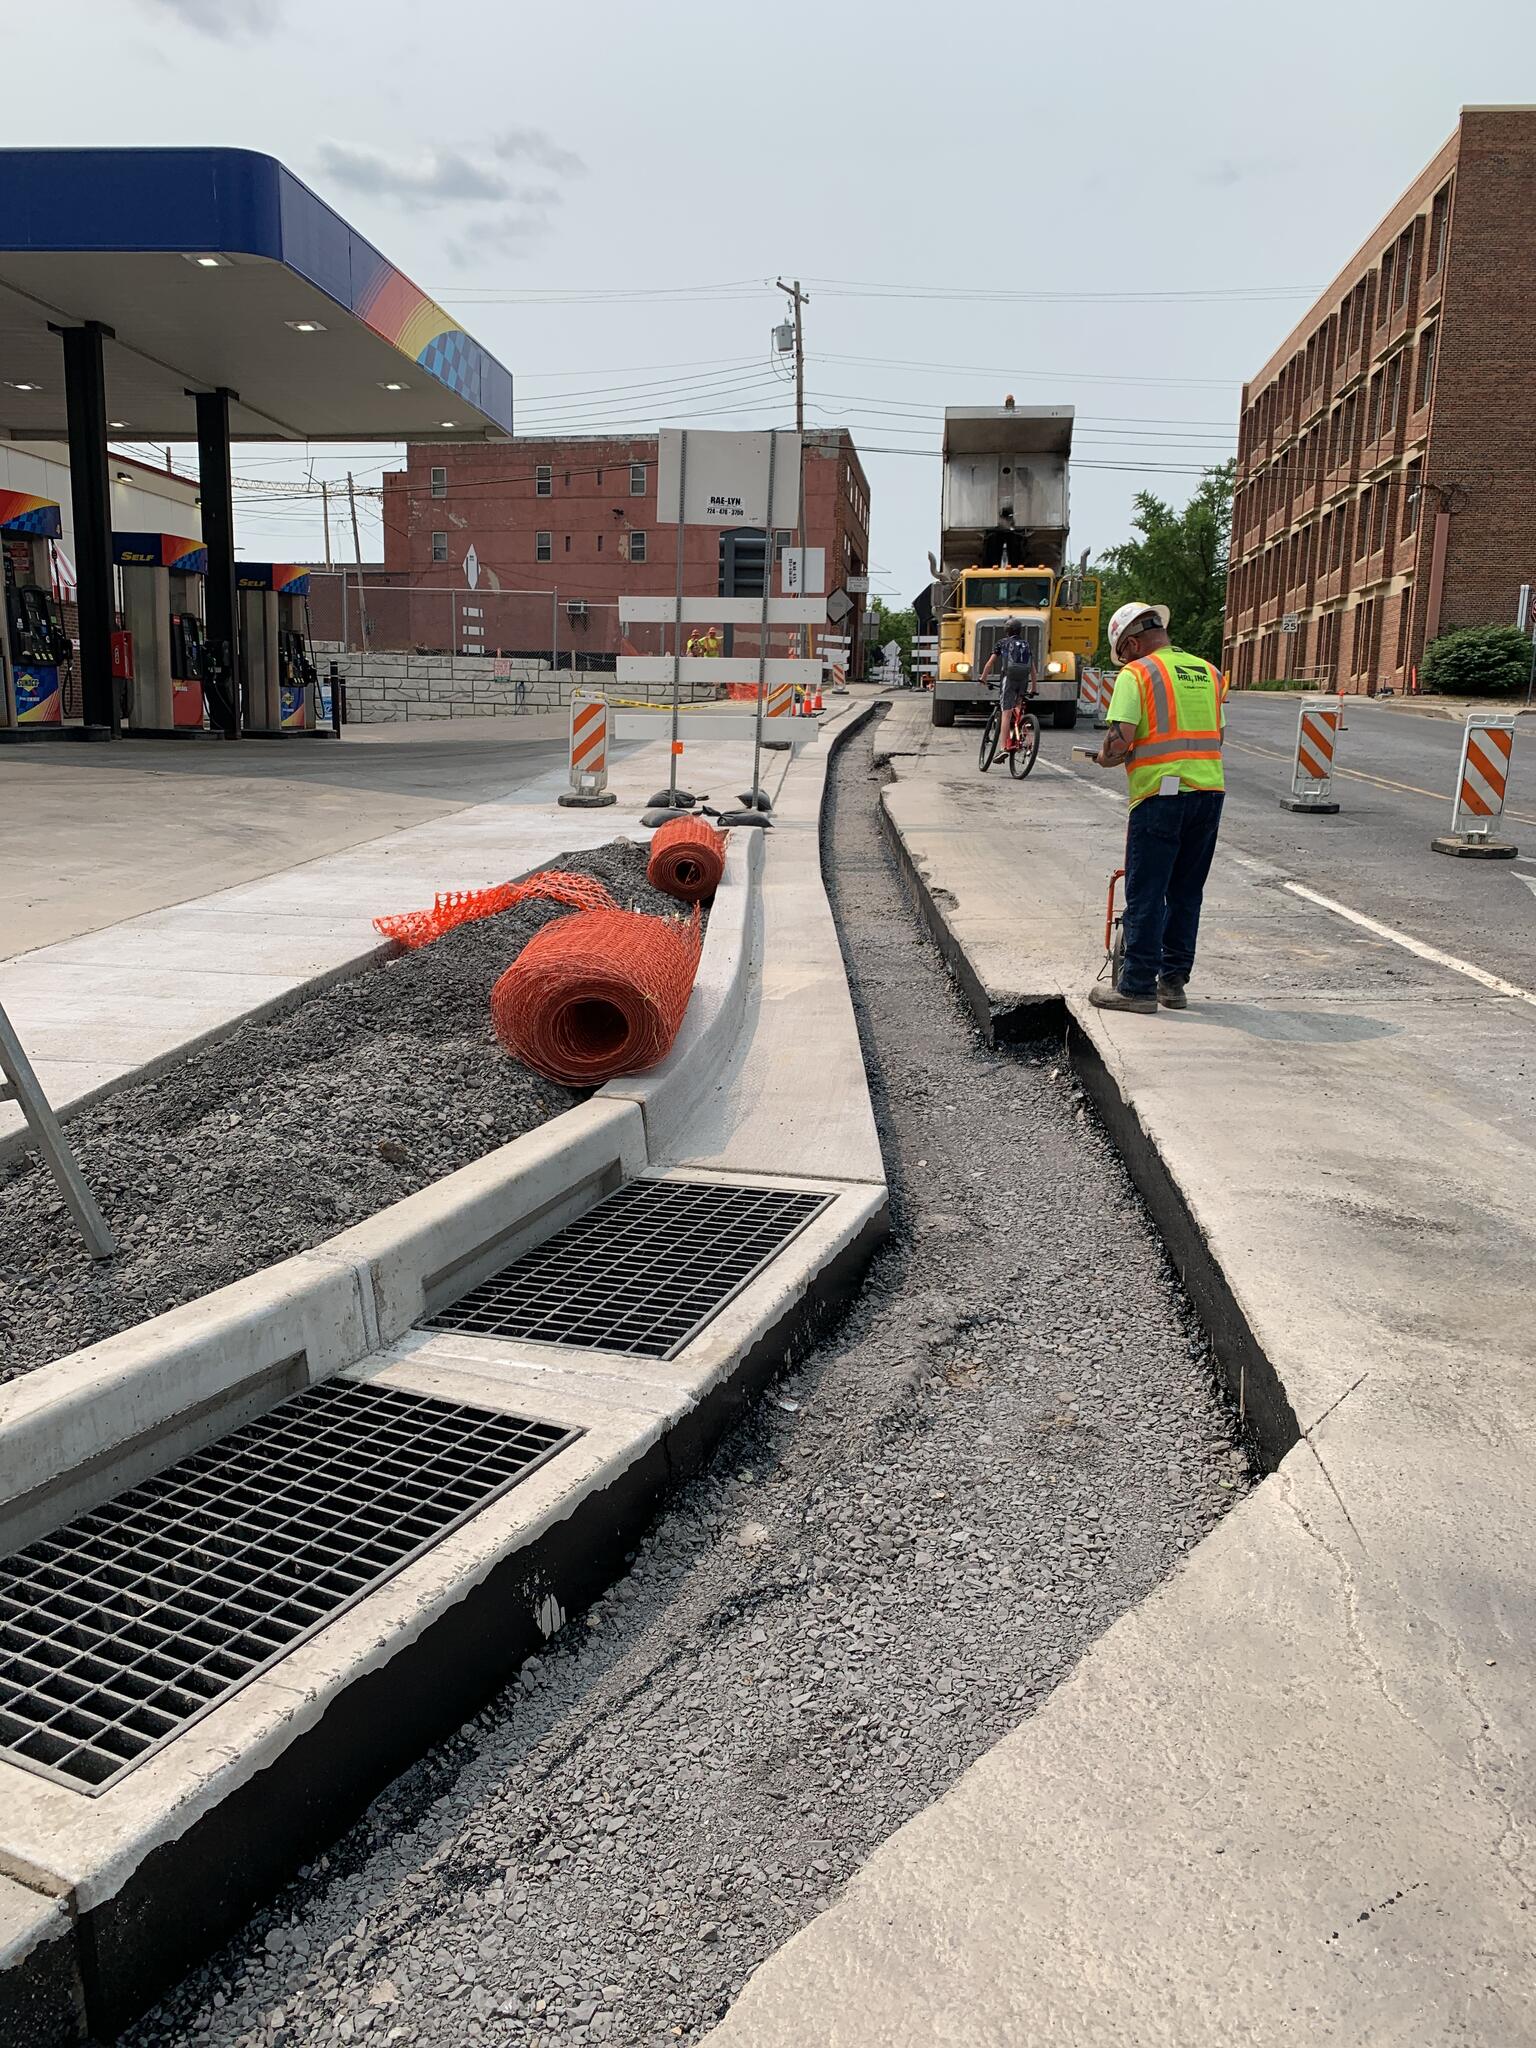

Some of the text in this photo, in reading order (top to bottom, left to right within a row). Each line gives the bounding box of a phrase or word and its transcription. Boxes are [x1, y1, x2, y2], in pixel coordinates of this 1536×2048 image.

[710, 496, 741, 505] RAE-LYN
[1283, 622, 1297, 631] 25
[1177, 673, 1211, 683] HRI, INC.
